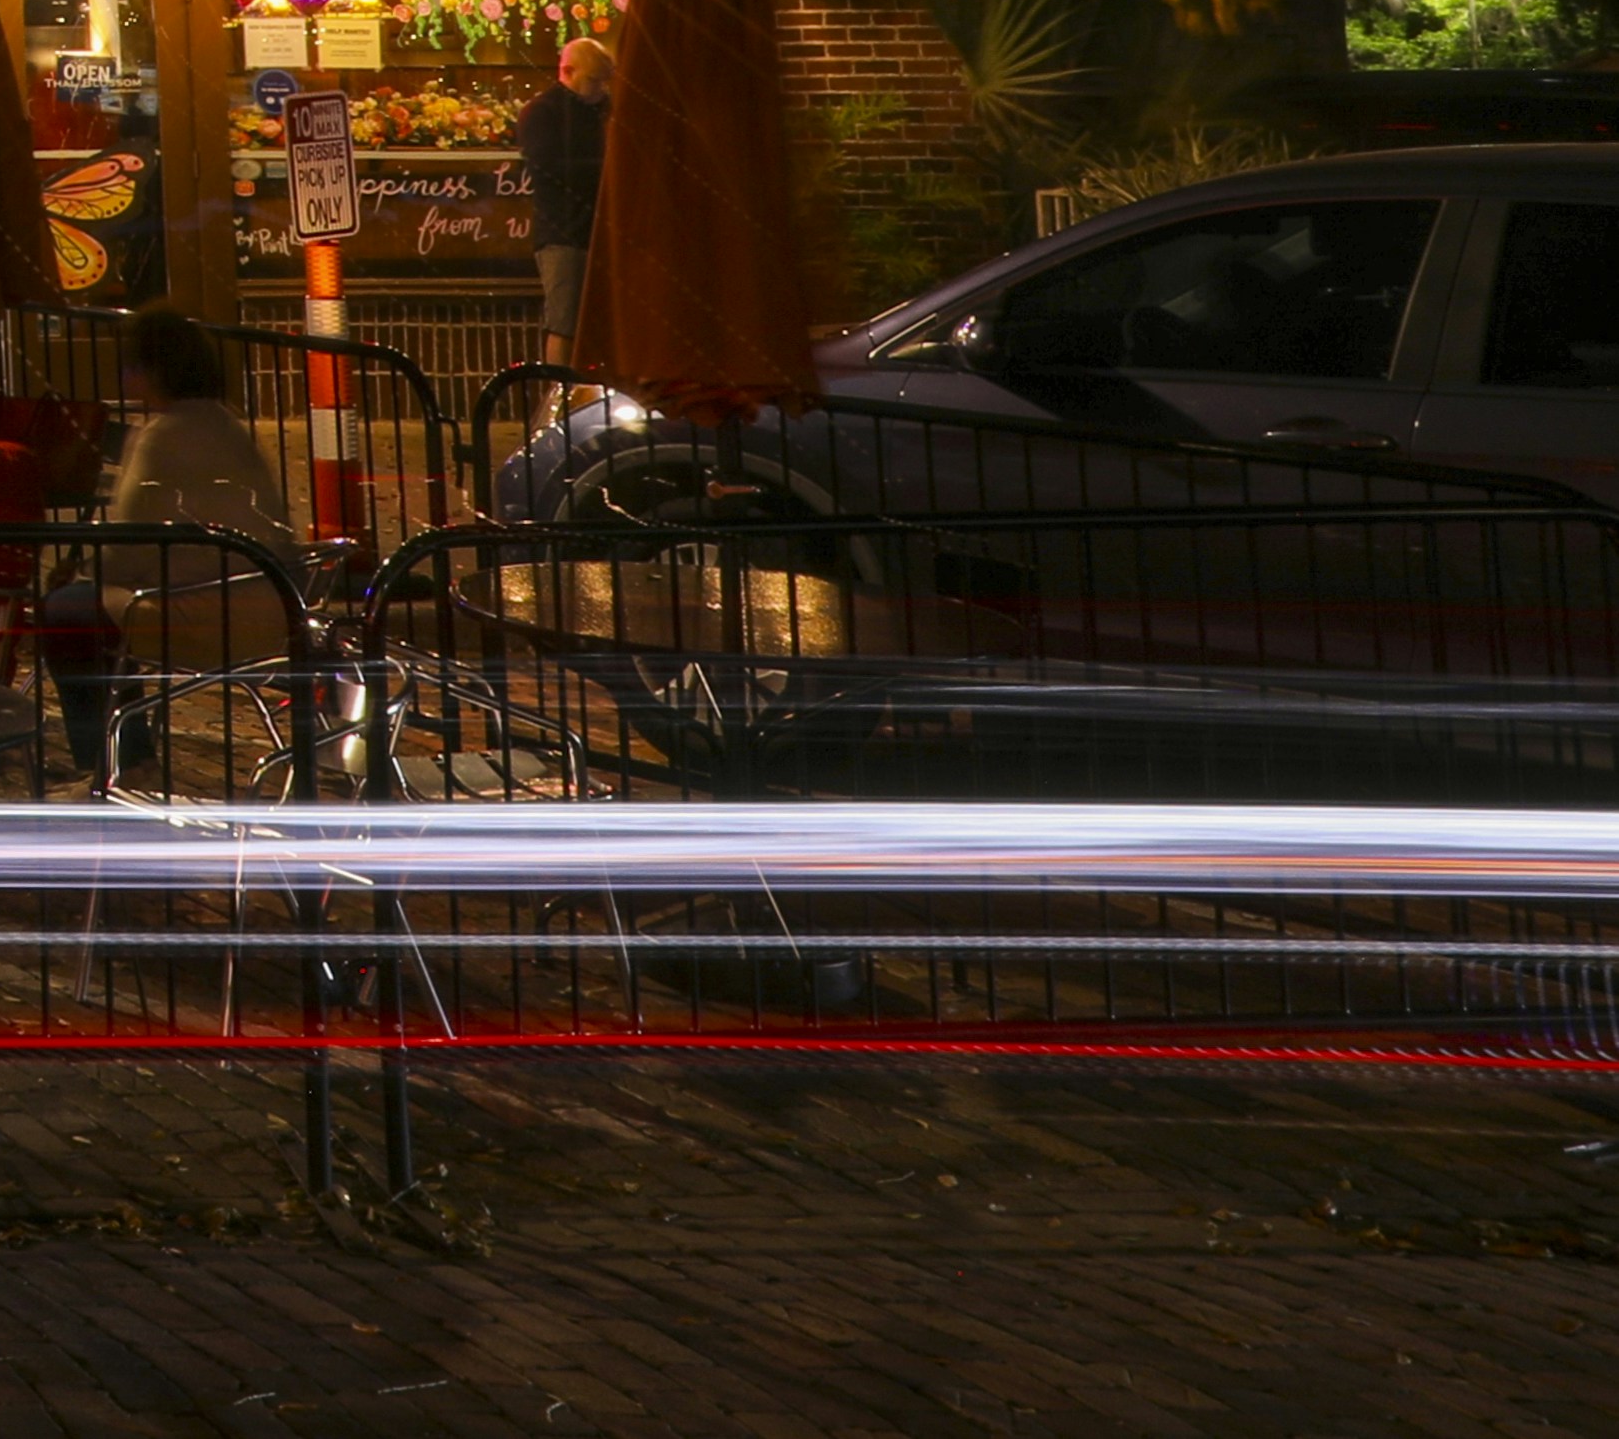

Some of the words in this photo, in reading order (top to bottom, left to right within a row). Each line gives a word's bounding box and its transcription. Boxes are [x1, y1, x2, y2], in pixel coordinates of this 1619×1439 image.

[63, 63, 111, 83] OPEN
[311, 102, 342, 115] MINUTE
[293, 105, 311, 138] 10
[316, 121, 340, 136] MAX
[295, 142, 344, 164] CURBSIDE
[298, 167, 325, 189] PICK
[330, 165, 345, 185] UP
[357, 167, 477, 215] ppiness
[307, 196, 343, 230] ONLY
[418, 205, 489, 256] from
